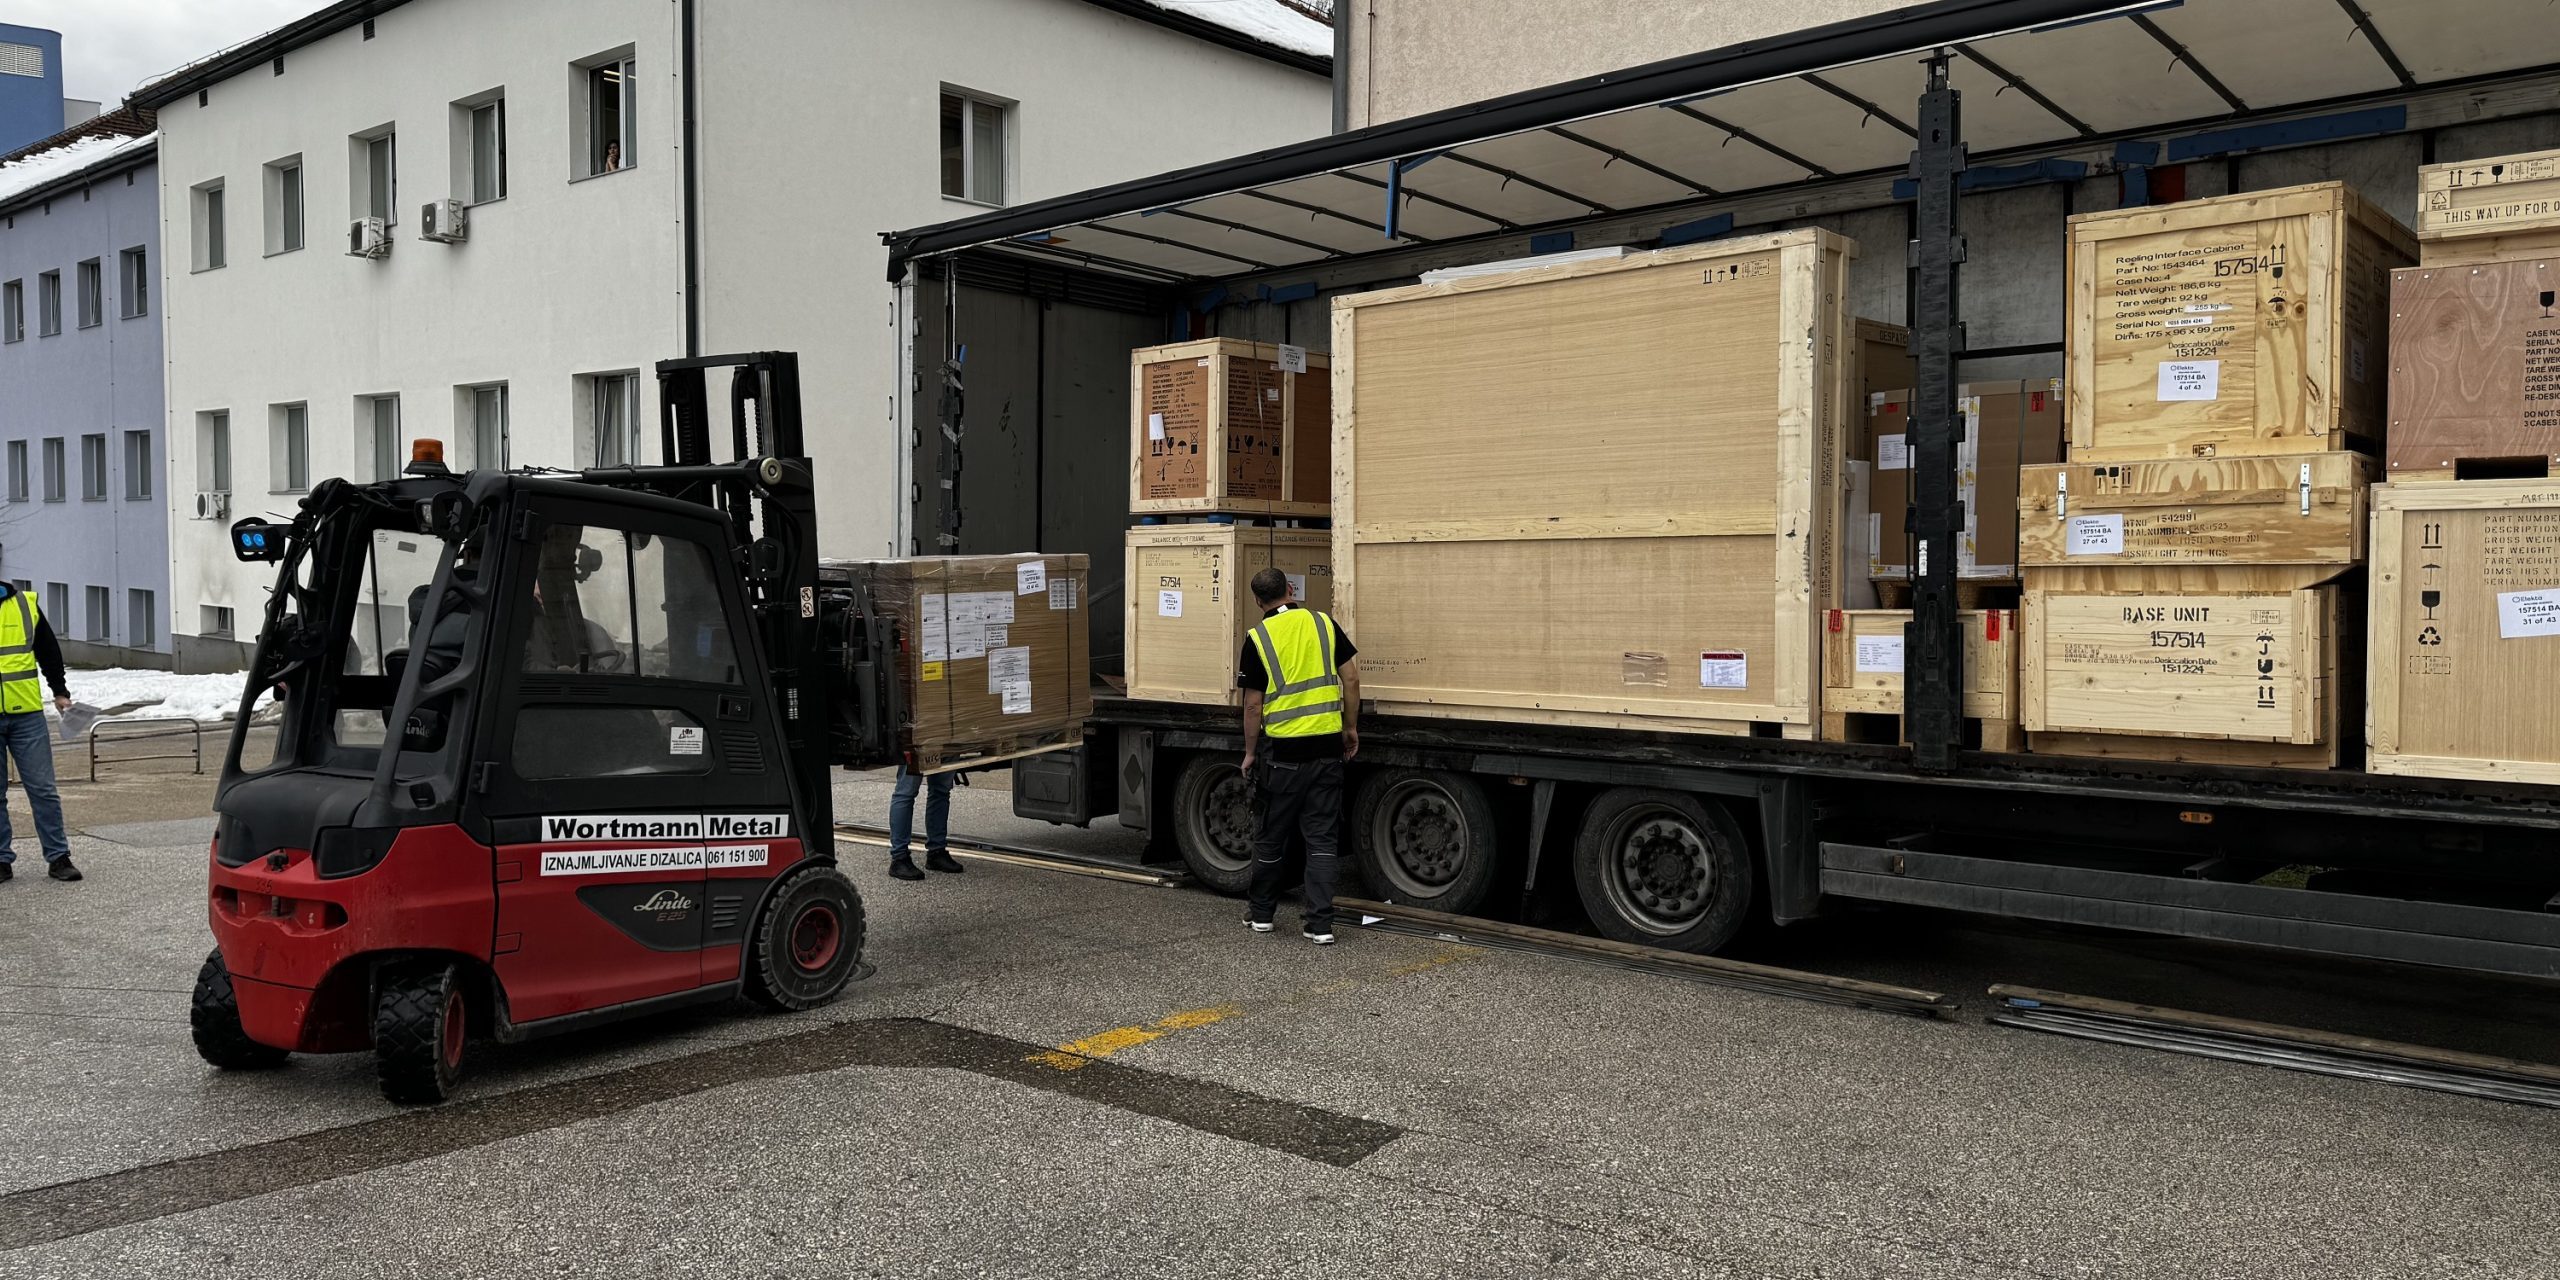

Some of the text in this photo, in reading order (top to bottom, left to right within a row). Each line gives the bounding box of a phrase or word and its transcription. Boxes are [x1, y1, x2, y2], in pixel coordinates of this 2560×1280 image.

[2444, 210, 2470, 223] THIS
[2476, 207, 2500, 220] WAY
[2506, 205, 2520, 216] UP
[2526, 202, 2548, 214] FOR
[2116, 244, 2245, 264] Reeling Interface Cabinet
[2116, 260, 2205, 275] Part No: 1543464
[2214, 256, 2269, 277] 157514
[2116, 278, 2142, 286] Case
[2144, 276, 2162, 284] No:
[2139, 285, 2176, 296] Weight:
[2179, 282, 2206, 291] 186,6
[2208, 281, 2221, 289] kg
[2116, 300, 2140, 308] Tare
[2142, 296, 2176, 306] weight:
[2194, 293, 2208, 301] kg
[2116, 310, 2146, 319] Gross
[2149, 306, 2183, 316] weight:
[2116, 321, 2144, 330] Serial
[2146, 320, 2162, 328] No:
[2115, 331, 2142, 340] Dims:
[2146, 331, 2162, 339] 175
[2197, 326, 2210, 334] 99
[2526, 338, 2556, 346] SERIAL
[2156, 514, 2197, 524] 1542991
[2123, 607, 2209, 622] BASE UNIT
[2518, 605, 2546, 613] 157514
[2150, 630, 2206, 648] 157514
[406, 716, 430, 738] inde
[548, 816, 781, 839] Wortmann Metal
[545, 849, 766, 871] IZNAJMLJIVANJE DIZALICA 061 151 900
[634, 890, 692, 912] Linde
